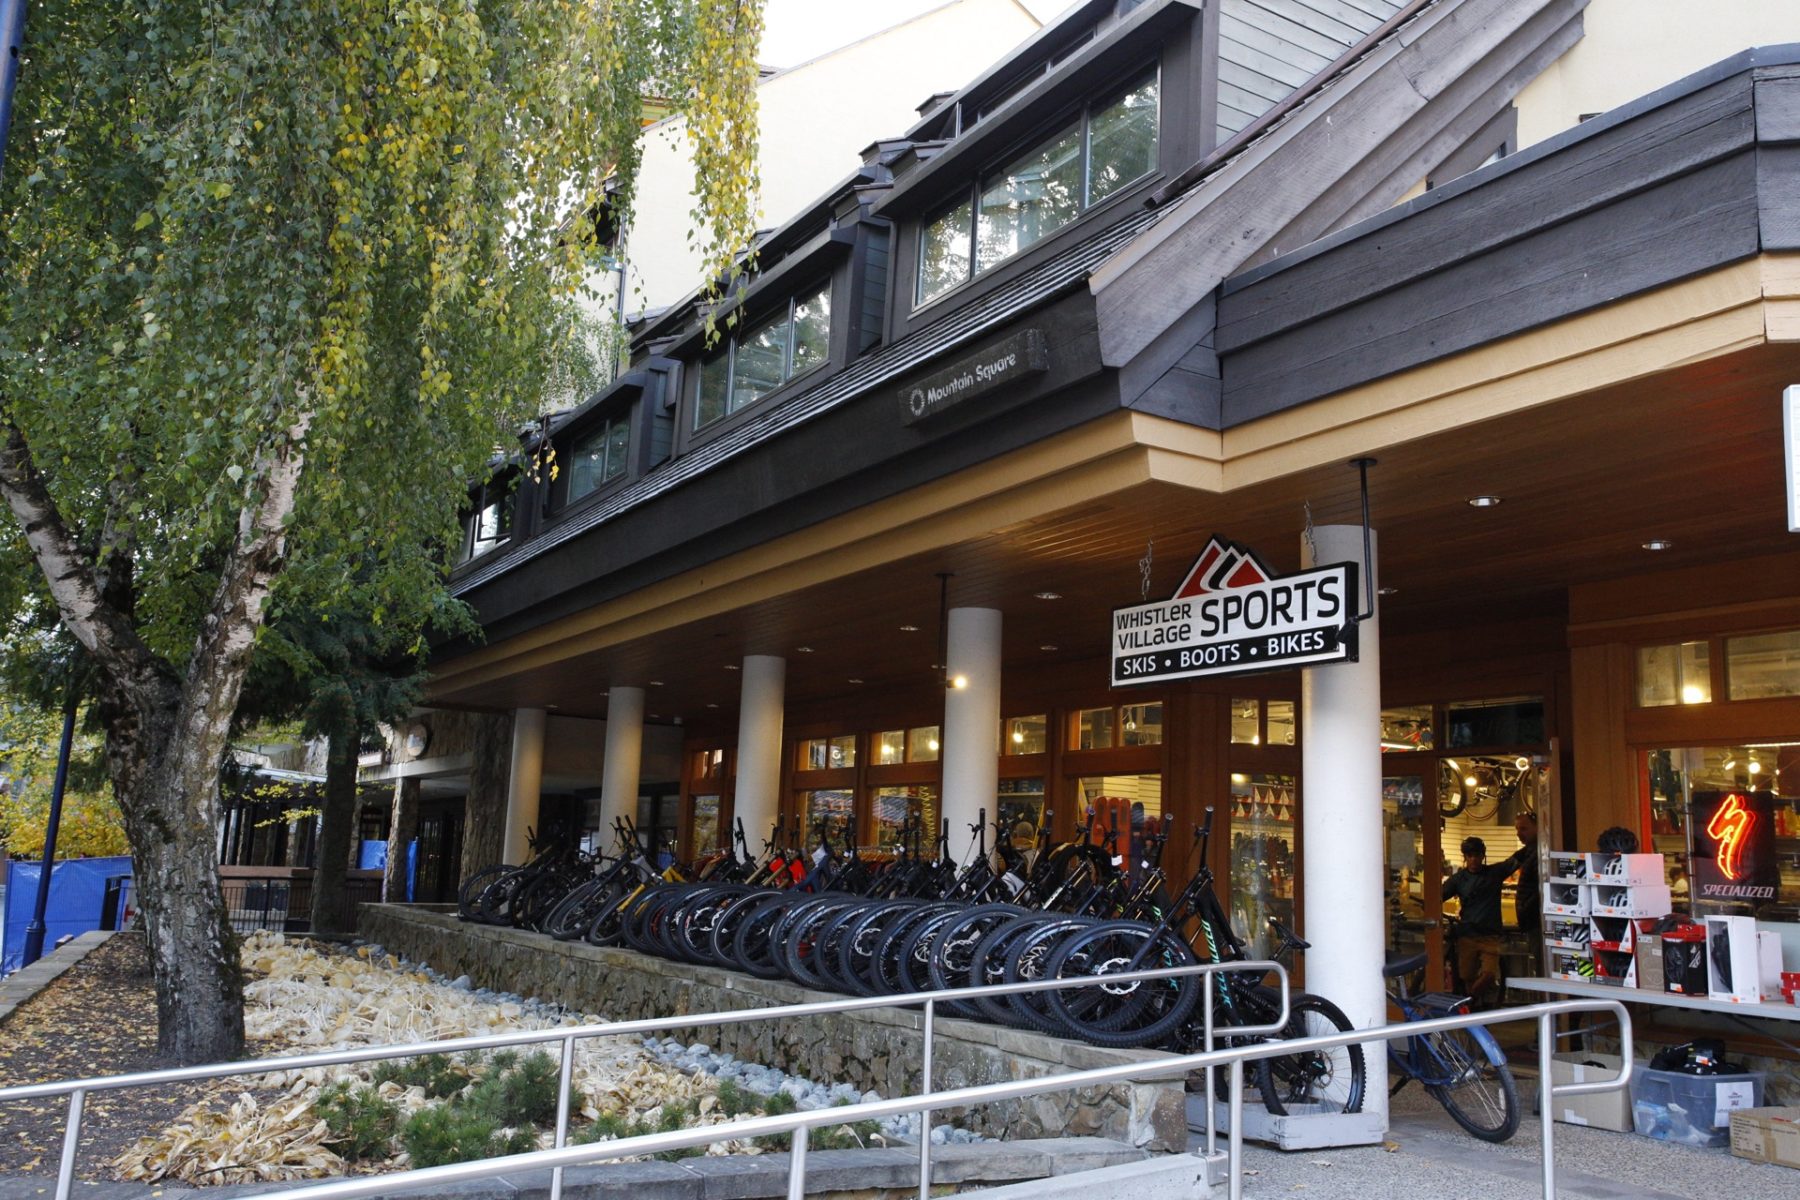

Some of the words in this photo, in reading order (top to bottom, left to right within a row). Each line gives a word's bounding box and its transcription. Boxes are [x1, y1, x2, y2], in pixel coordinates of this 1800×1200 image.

[927, 372, 974, 405] Mountain
[975, 353, 1016, 382] Square
[1200, 576, 1339, 637] SPORTS
[1123, 655, 1156, 675] SKIS
[1180, 643, 1240, 668] BOOTS
[1267, 631, 1325, 657] BIKES
[1701, 884, 1774, 898] SPECIALIZED
